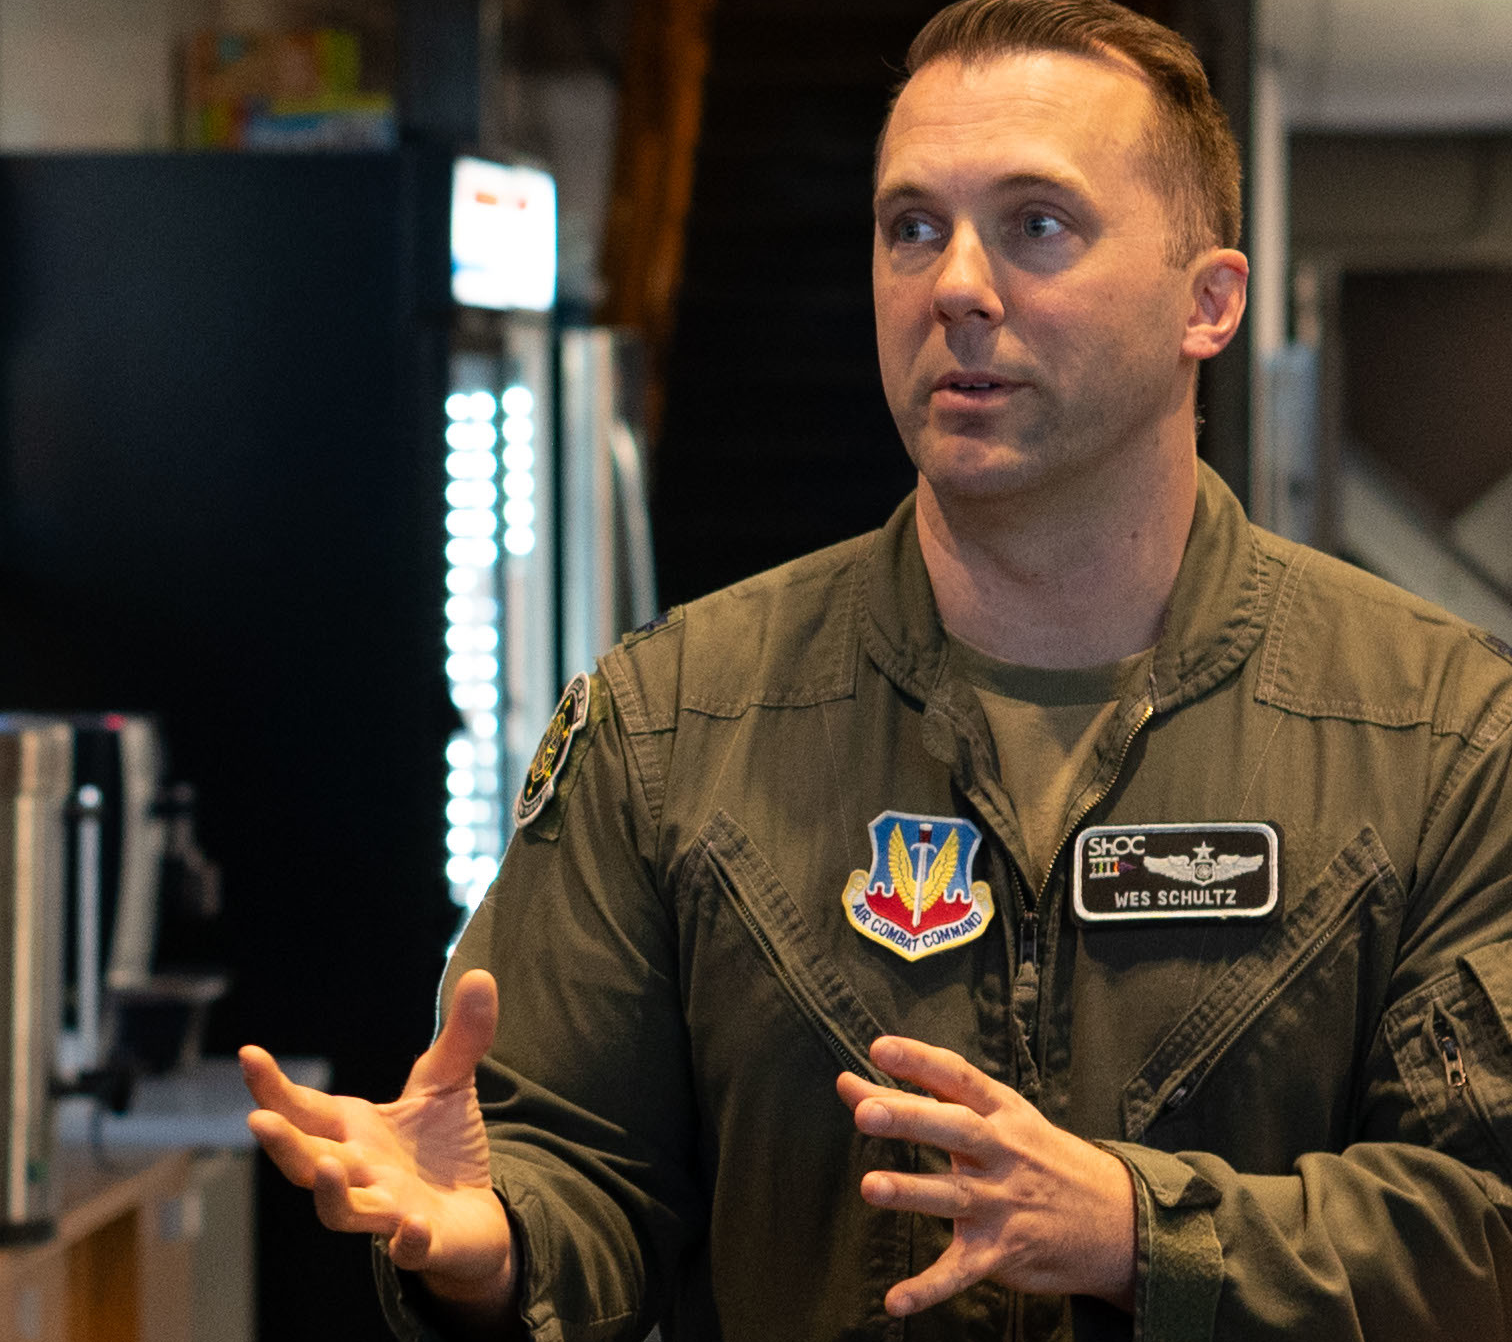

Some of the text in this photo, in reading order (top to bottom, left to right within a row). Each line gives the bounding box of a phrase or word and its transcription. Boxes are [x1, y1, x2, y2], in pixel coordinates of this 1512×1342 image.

[1114, 889, 1237, 908] WES SCHULTZ
[852, 903, 983, 952] AIR COMBAT COMMAND
